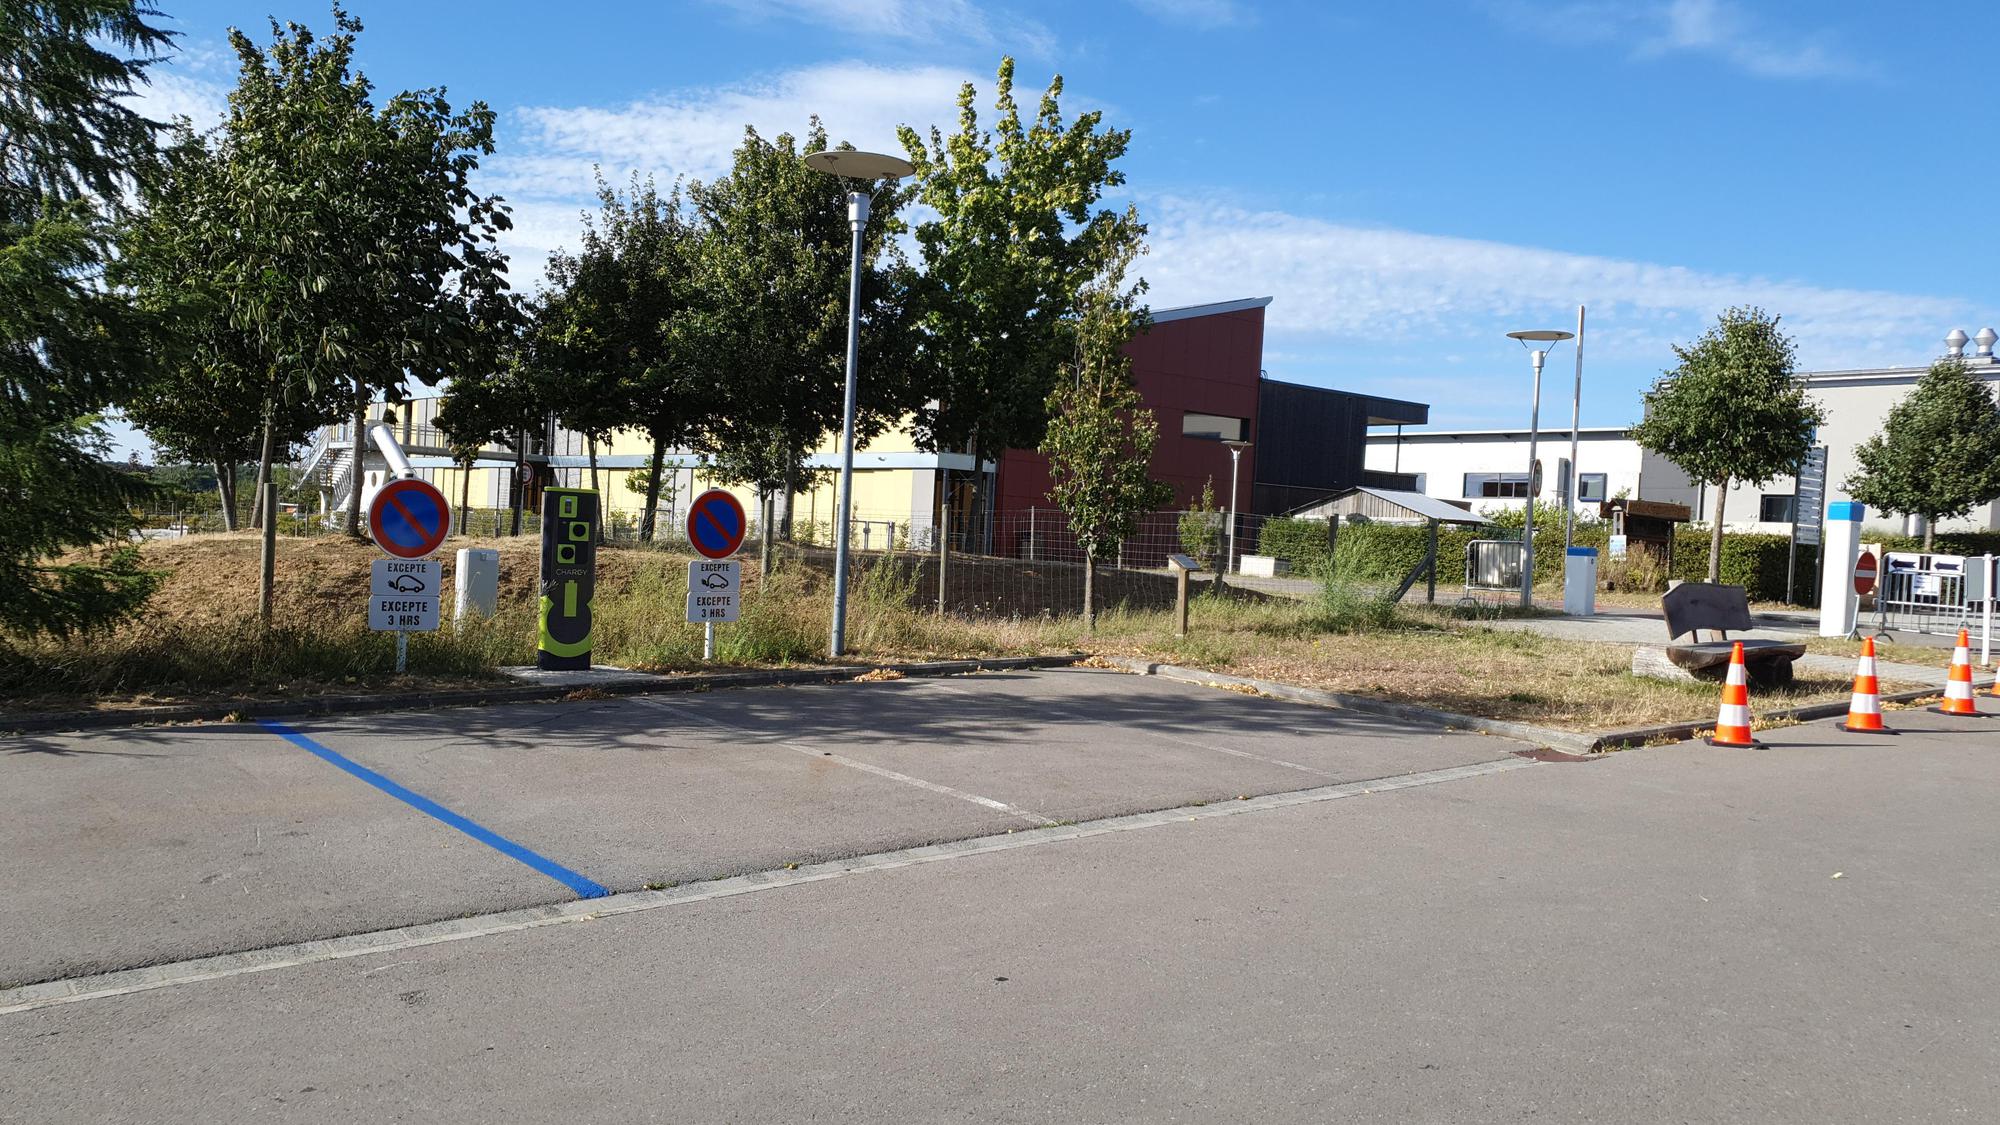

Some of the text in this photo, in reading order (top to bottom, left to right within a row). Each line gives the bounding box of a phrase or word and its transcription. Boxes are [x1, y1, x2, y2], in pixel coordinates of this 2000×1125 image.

[387, 563, 427, 573] EXCEPTE
[381, 601, 428, 612] EXCEPTE
[696, 597, 731, 606] EXCEPTE
[701, 609, 726, 618] 3 HRS
[388, 615, 420, 626] 3 HRS
